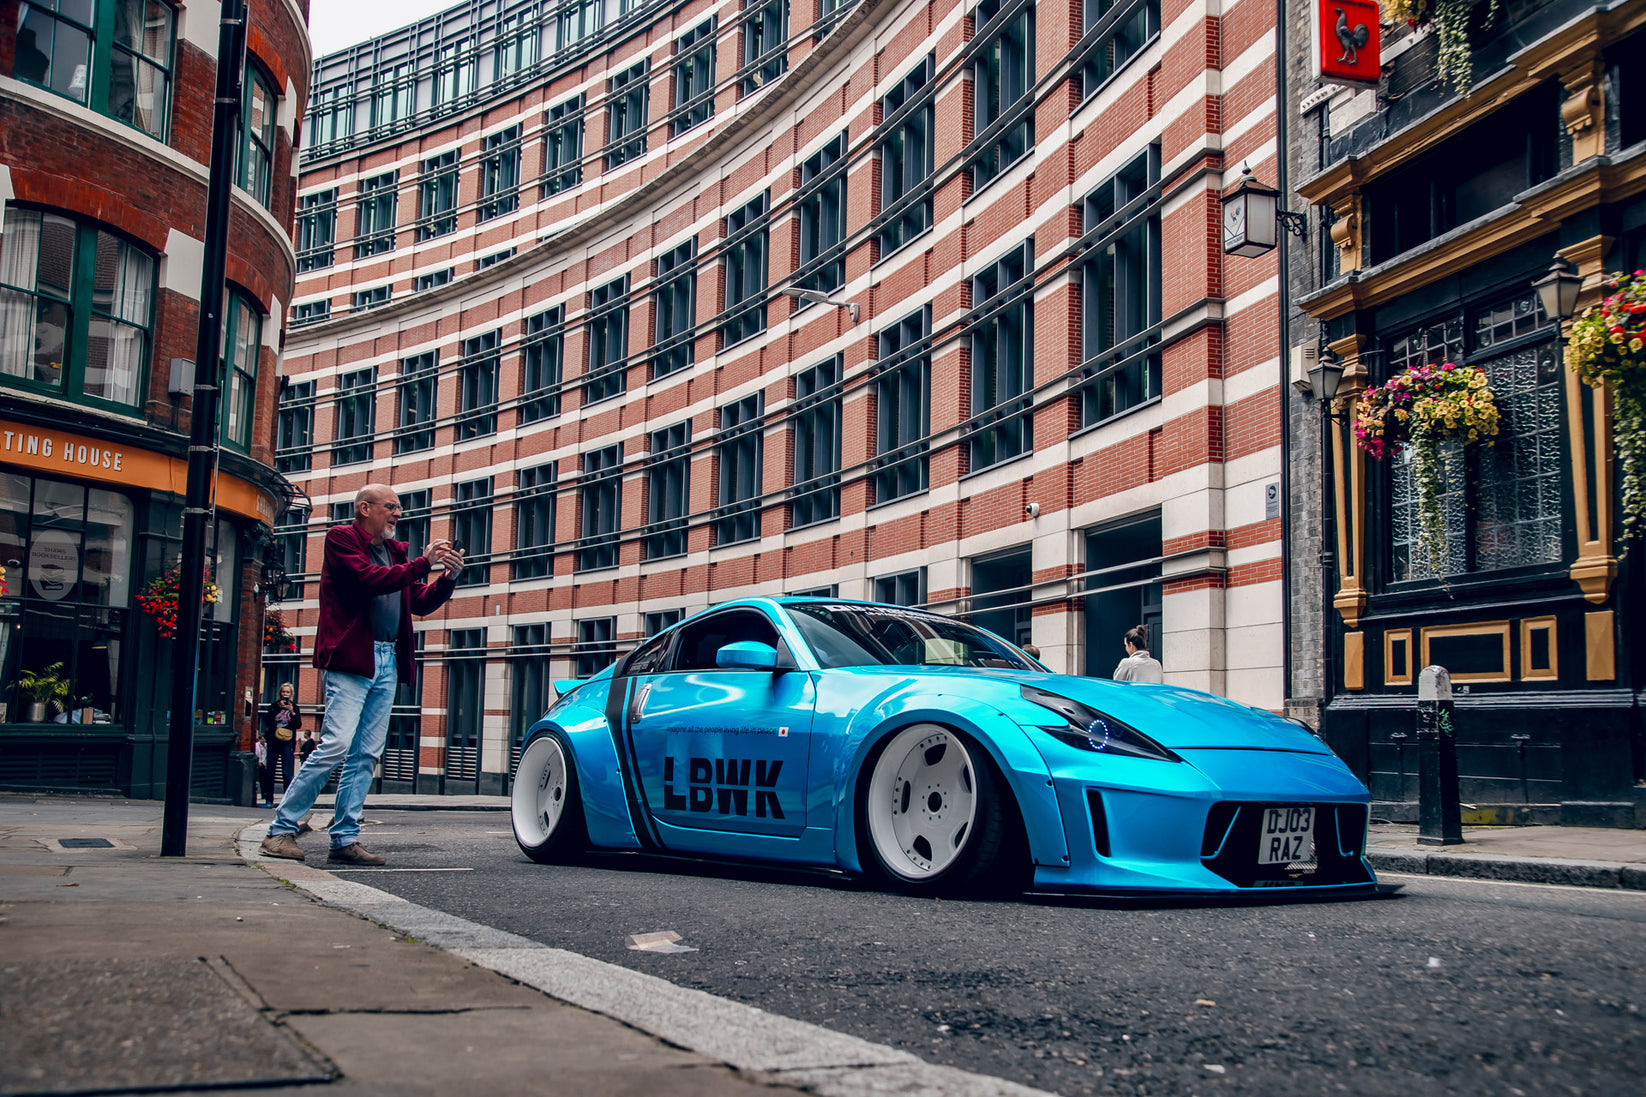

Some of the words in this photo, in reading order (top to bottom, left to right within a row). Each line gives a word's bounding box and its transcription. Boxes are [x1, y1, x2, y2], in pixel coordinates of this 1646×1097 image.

[0, 430, 53, 457] TING
[63, 442, 123, 471] HOUSE
[704, 725, 723, 736] people
[757, 728, 777, 736] peace
[664, 756, 785, 820] LBWK
[1267, 808, 1311, 834] DJ03
[1269, 836, 1303, 862] RAZ
